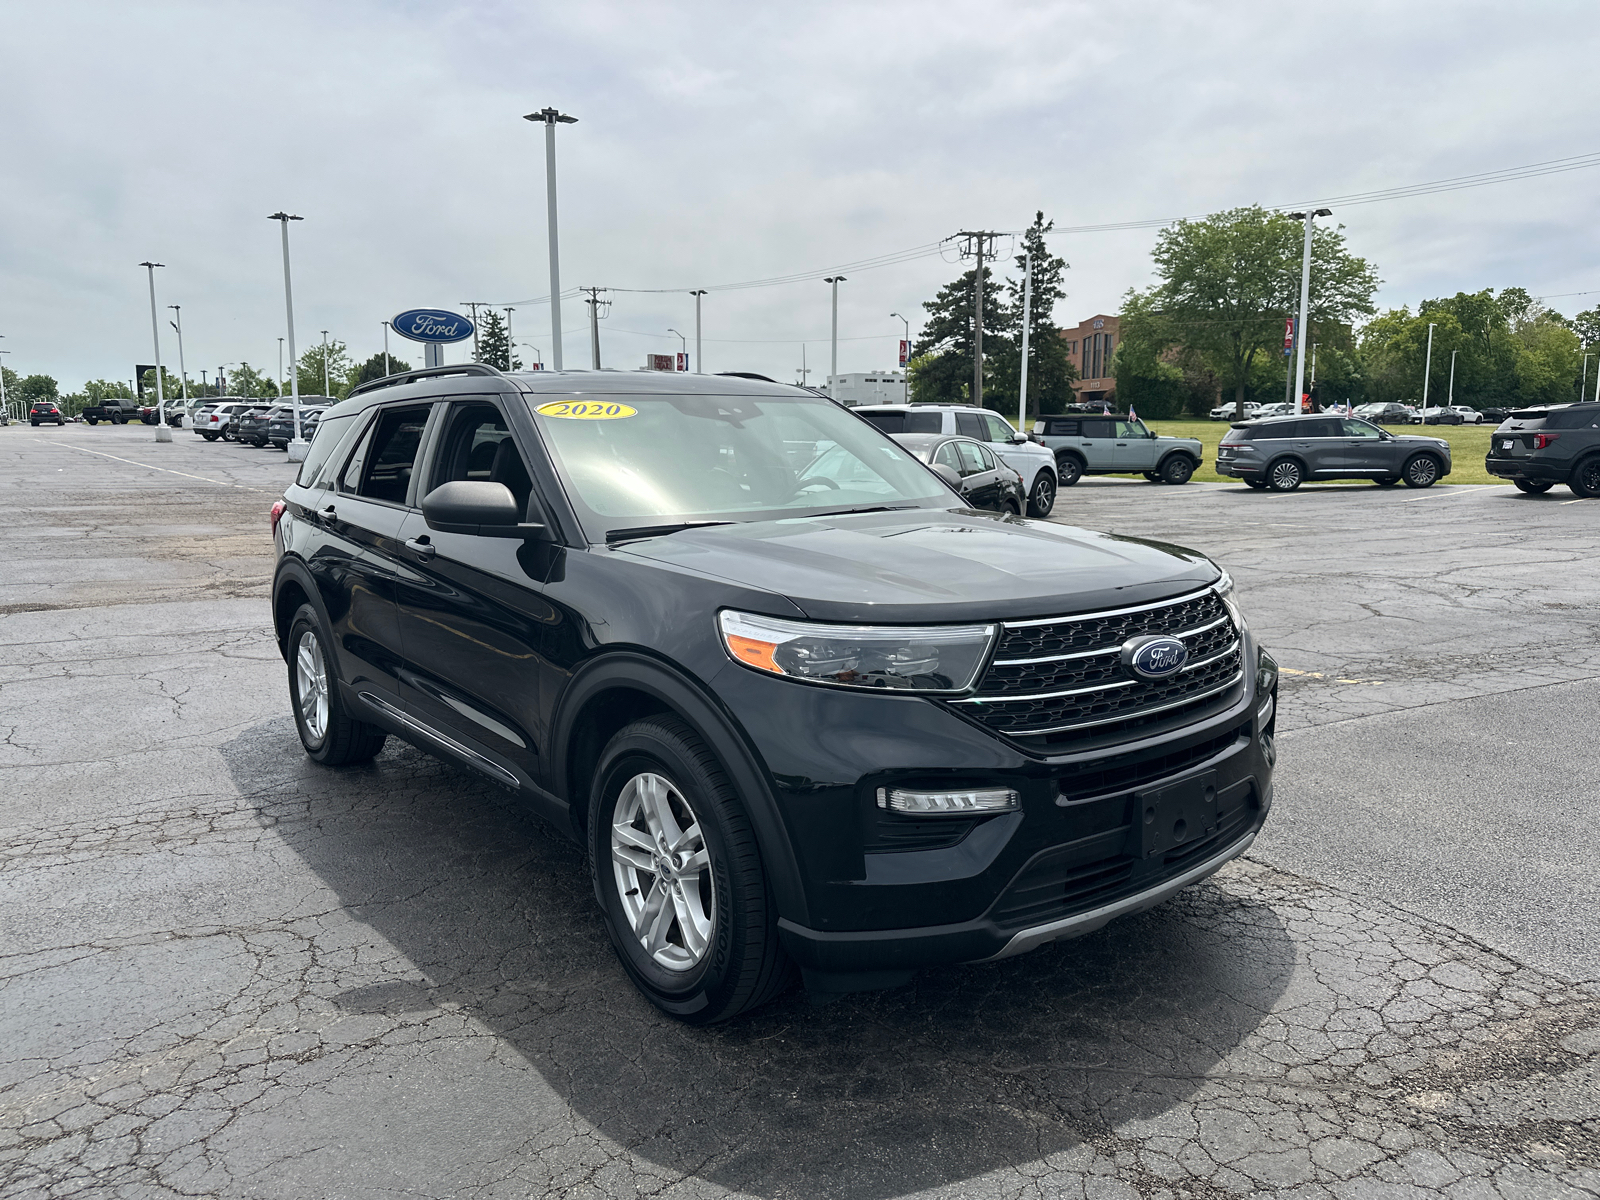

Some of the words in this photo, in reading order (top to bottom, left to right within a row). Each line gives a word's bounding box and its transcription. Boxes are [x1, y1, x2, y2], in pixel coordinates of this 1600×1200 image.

[411, 314, 459, 336] Ford
[554, 404, 621, 416] 2020
[1149, 646, 1179, 670] Ford
